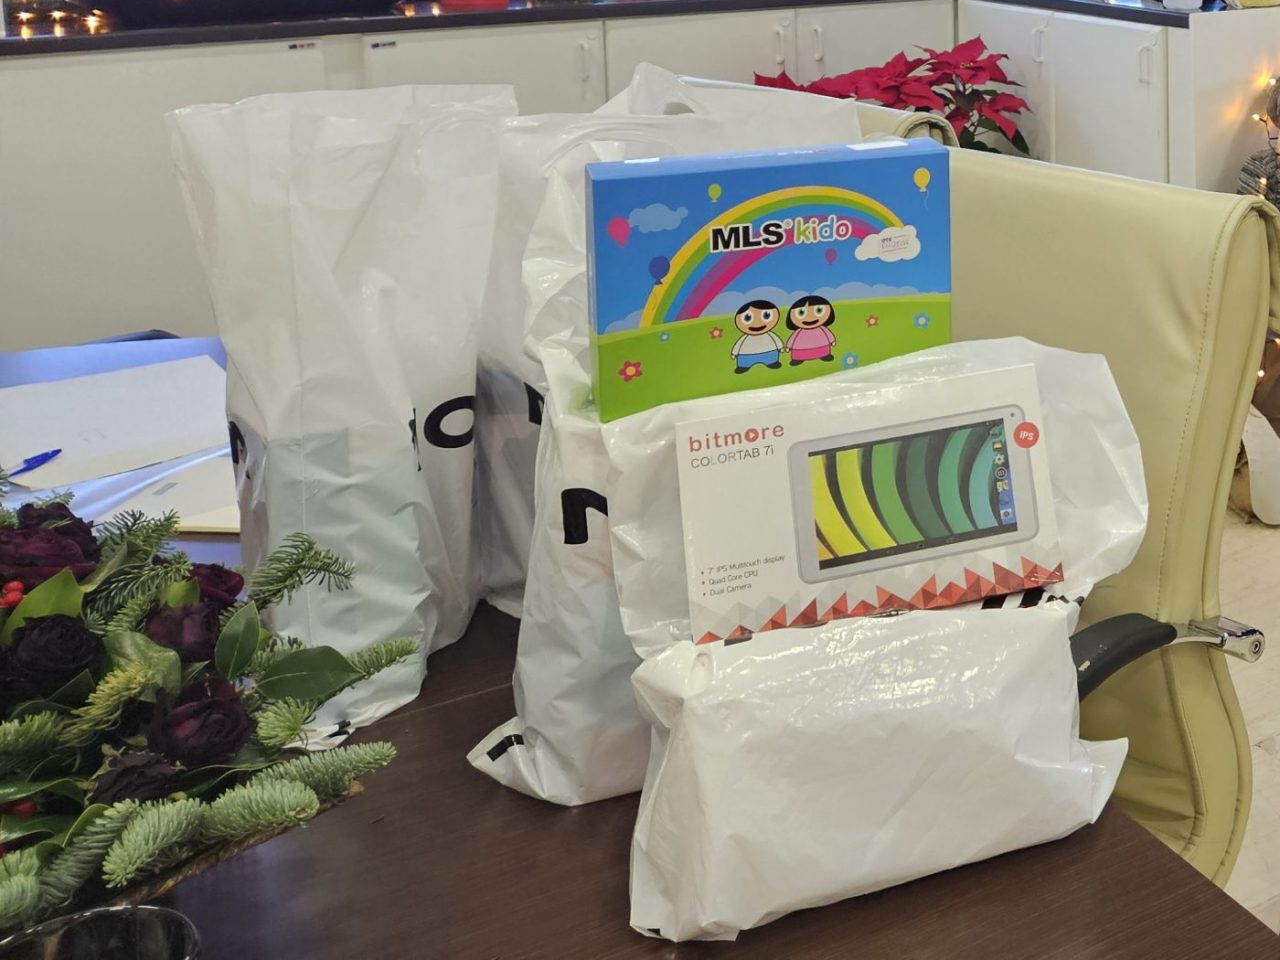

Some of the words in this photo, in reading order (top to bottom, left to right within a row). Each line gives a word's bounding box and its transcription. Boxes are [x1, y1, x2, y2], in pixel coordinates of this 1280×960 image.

[794, 215, 851, 243] kido
[689, 424, 785, 453] bitmore
[1019, 430, 1034, 441] IPS
[690, 447, 761, 469] COLORTAB
[763, 444, 774, 456] 7i
[716, 564, 728, 573] IPS
[763, 555, 785, 565] display
[709, 576, 726, 586] Quad
[727, 574, 743, 582] Core
[743, 570, 759, 579] CPU
[710, 587, 725, 597] Dual
[726, 583, 752, 593] Camera
